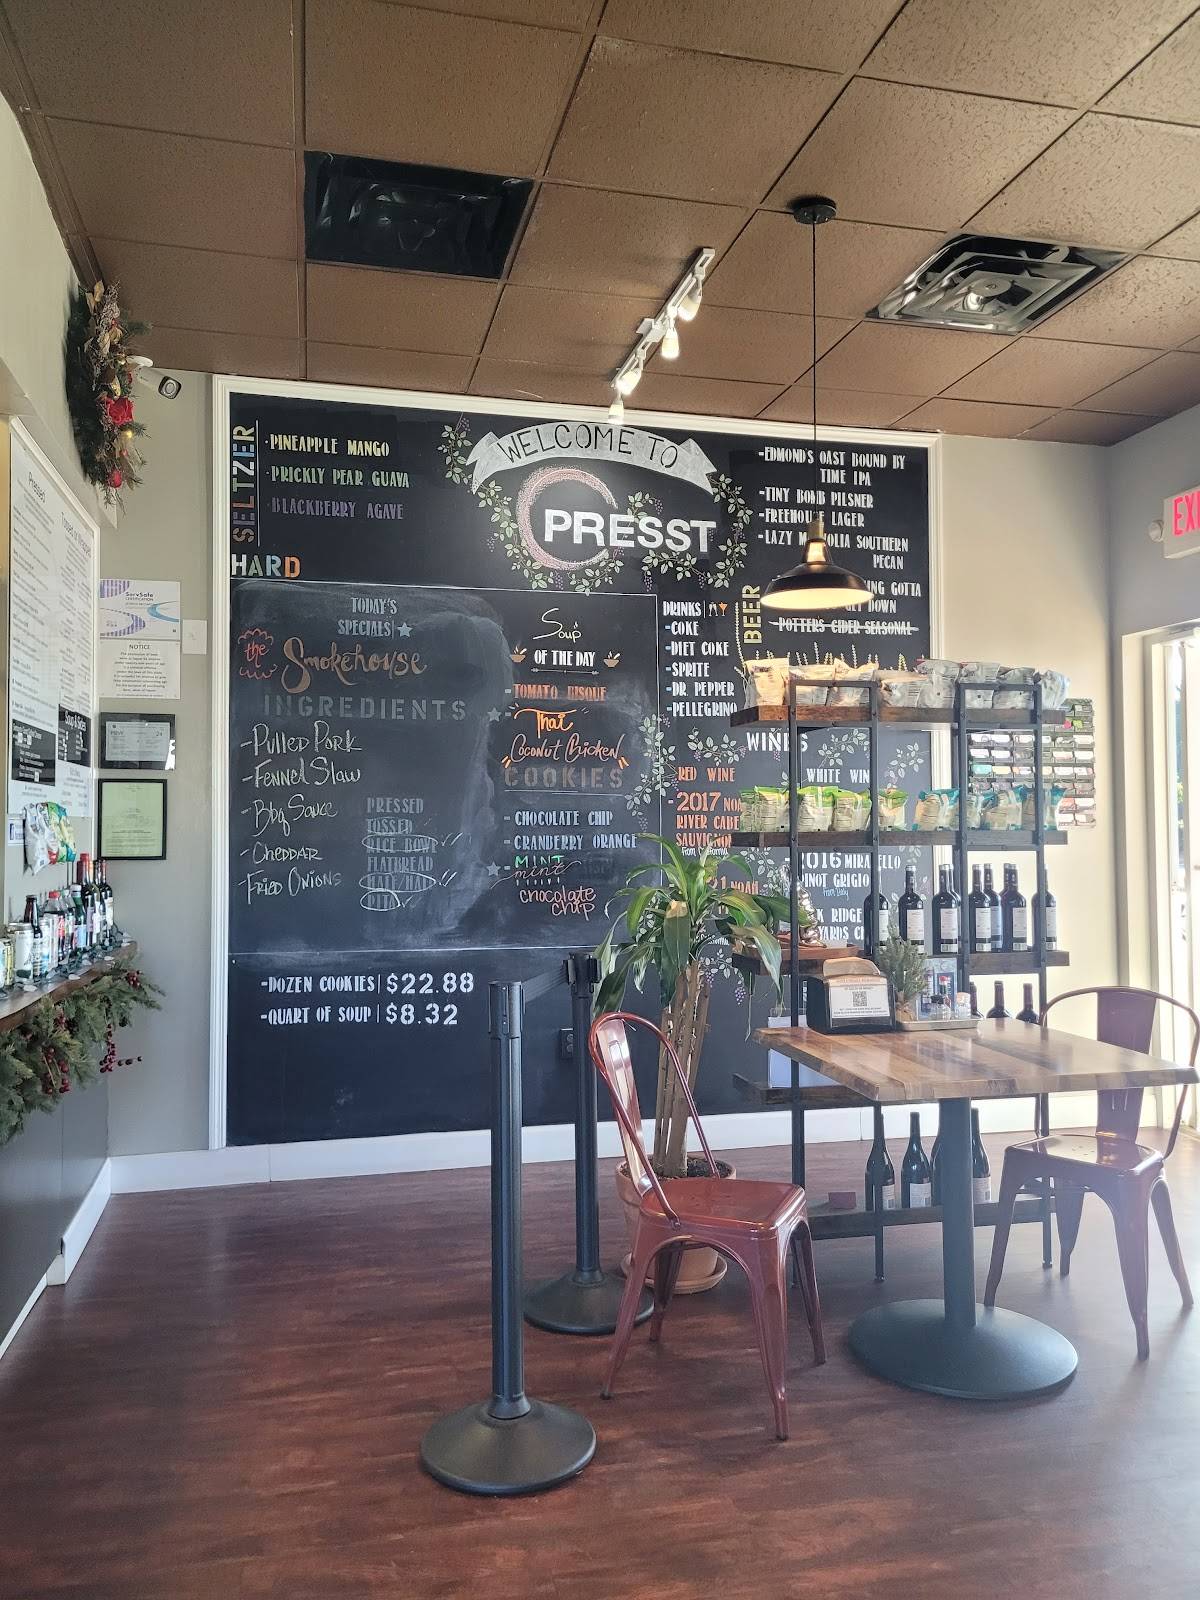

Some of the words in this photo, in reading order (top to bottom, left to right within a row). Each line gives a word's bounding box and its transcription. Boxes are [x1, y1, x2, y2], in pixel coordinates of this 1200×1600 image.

[269, 433, 338, 455] PINEAPPLE
[347, 440, 390, 457] MANGO
[497, 424, 635, 464] WELCOME
[648, 436, 679, 469] TO
[820, 450, 846, 466] OAST
[852, 453, 887, 469] BOUND
[892, 455, 906, 470] BY
[232, 425, 255, 544] SELTZER
[271, 465, 325, 485] PRICKLY
[332, 470, 364, 486] PEAR
[372, 471, 410, 489] GUAVA
[820, 468, 846, 484] TIME
[853, 471, 872, 487] IPA
[765, 486, 790, 503] TINY
[831, 491, 874, 509] PILSNER
[271, 497, 356, 518] BLACKBERRY
[366, 503, 404, 520] AGAVE
[1173, 490, 1200, 536] EXI
[765, 508, 825, 525] FREEHOUE
[831, 511, 865, 528] LAGER
[543, 508, 717, 553] PRESST
[765, 530, 792, 546] LAZY
[856, 535, 909, 553] SOUTHERN
[230, 553, 301, 578] HARD
[873, 553, 904, 570] PECAN
[890, 581, 922, 597] GOTTA
[351, 597, 398, 615] TODAY'S
[662, 601, 702, 617] DRINKS
[742, 584, 763, 644] BEER
[868, 599, 897, 613] DOWN
[337, 619, 392, 637] SPECIALS
[533, 607, 582, 643] Soup
[670, 621, 699, 636] COKE
[671, 641, 696, 657] DIET
[701, 641, 729, 657] COKE
[534, 650, 548, 664] OF
[551, 650, 573, 666] THE
[576, 652, 596, 667] DAY
[671, 662, 710, 678] SPRITE
[512, 683, 559, 700] TOMATO
[566, 685, 608, 702] BISQUE
[694, 681, 735, 697] PEPPER
[263, 695, 467, 721] INGREDIENTS
[672, 702, 738, 718] PELLEGRINO
[514, 708, 578, 739] Thai
[504, 767, 624, 789] COOKIES
[677, 767, 697, 782] RED
[707, 767, 736, 783] WINE
[806, 768, 841, 783] WHITE
[849, 769, 870, 784] WIN
[366, 797, 424, 814] PRESSED
[676, 791, 722, 812] 2017
[723, 797, 742, 812] NOA
[366, 818, 413, 835] TOSSED
[515, 810, 580, 827] CHOCOLATE
[588, 811, 613, 826] CHIP
[676, 814, 708, 830] RIVER
[514, 834, 584, 851] CRANBERRY
[592, 833, 637, 849] ORANGE
[366, 855, 434, 873] FLATBREAD
[801, 852, 842, 869] 016
[833, 873, 870, 888] GRIGIO
[831, 908, 863, 922] RIDGE
[268, 976, 313, 993] DOZEN
[320, 975, 375, 992] COOKIES
[386, 972, 475, 994] $22.88
[268, 1007, 311, 1025] QUART
[317, 1006, 332, 1022] OF
[338, 1006, 372, 1023] SOUP
[386, 1002, 458, 1025] $8.32
